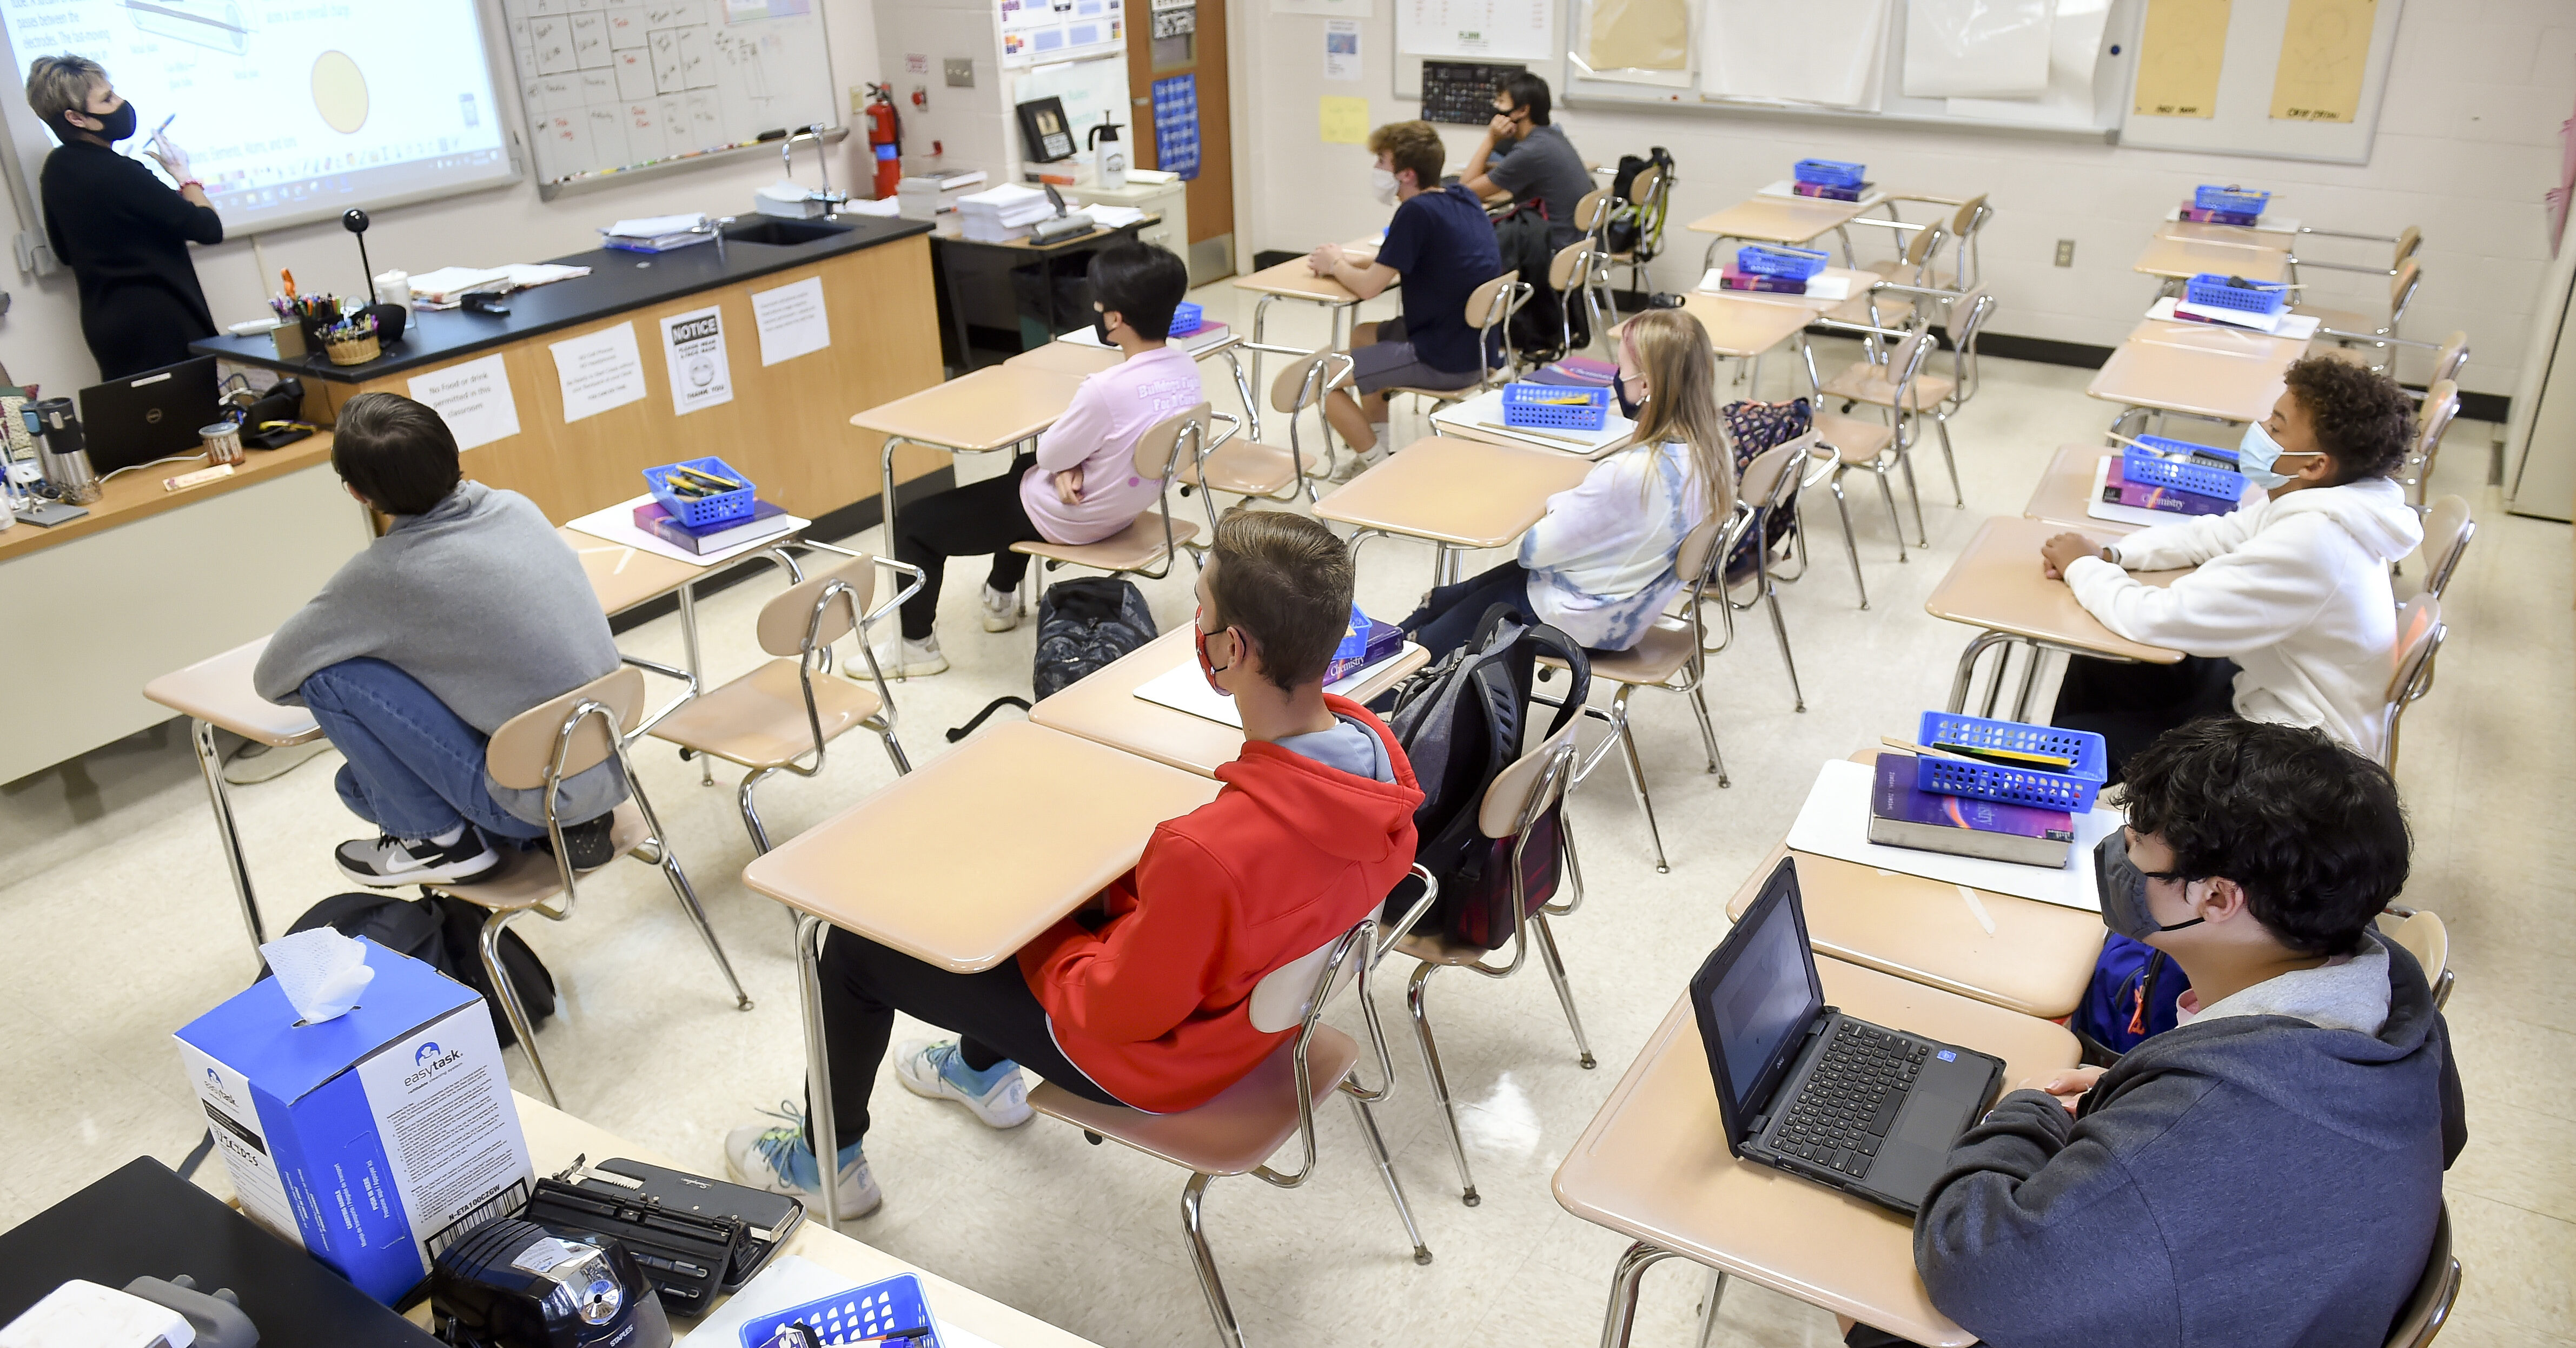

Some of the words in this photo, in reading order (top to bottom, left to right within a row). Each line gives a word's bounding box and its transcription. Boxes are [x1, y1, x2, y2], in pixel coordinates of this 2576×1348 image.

[672, 318, 716, 343] NOTICE
[679, 343, 699, 352] PLEASE
[429, 386, 440, 395] No
[441, 380, 459, 390] Food
[470, 372, 489, 383] drink
[1137, 379, 1180, 399] Bulldogs
[433, 393, 468, 409] permitted
[478, 385, 491, 395] this
[687, 389, 708, 400] THANK
[1153, 398, 1170, 412] For
[1171, 394, 1178, 408] A
[448, 402, 484, 418] classroom
[2142, 493, 2185, 511] Chemistry
[1330, 656, 1364, 676] Chemistry
[362, 1176, 372, 1191] HERE
[369, 1195, 379, 1211] PUSH
[448, 1184, 500, 1221] N-ETA100CZGW
[610, 1324, 633, 1347] STAPLES
